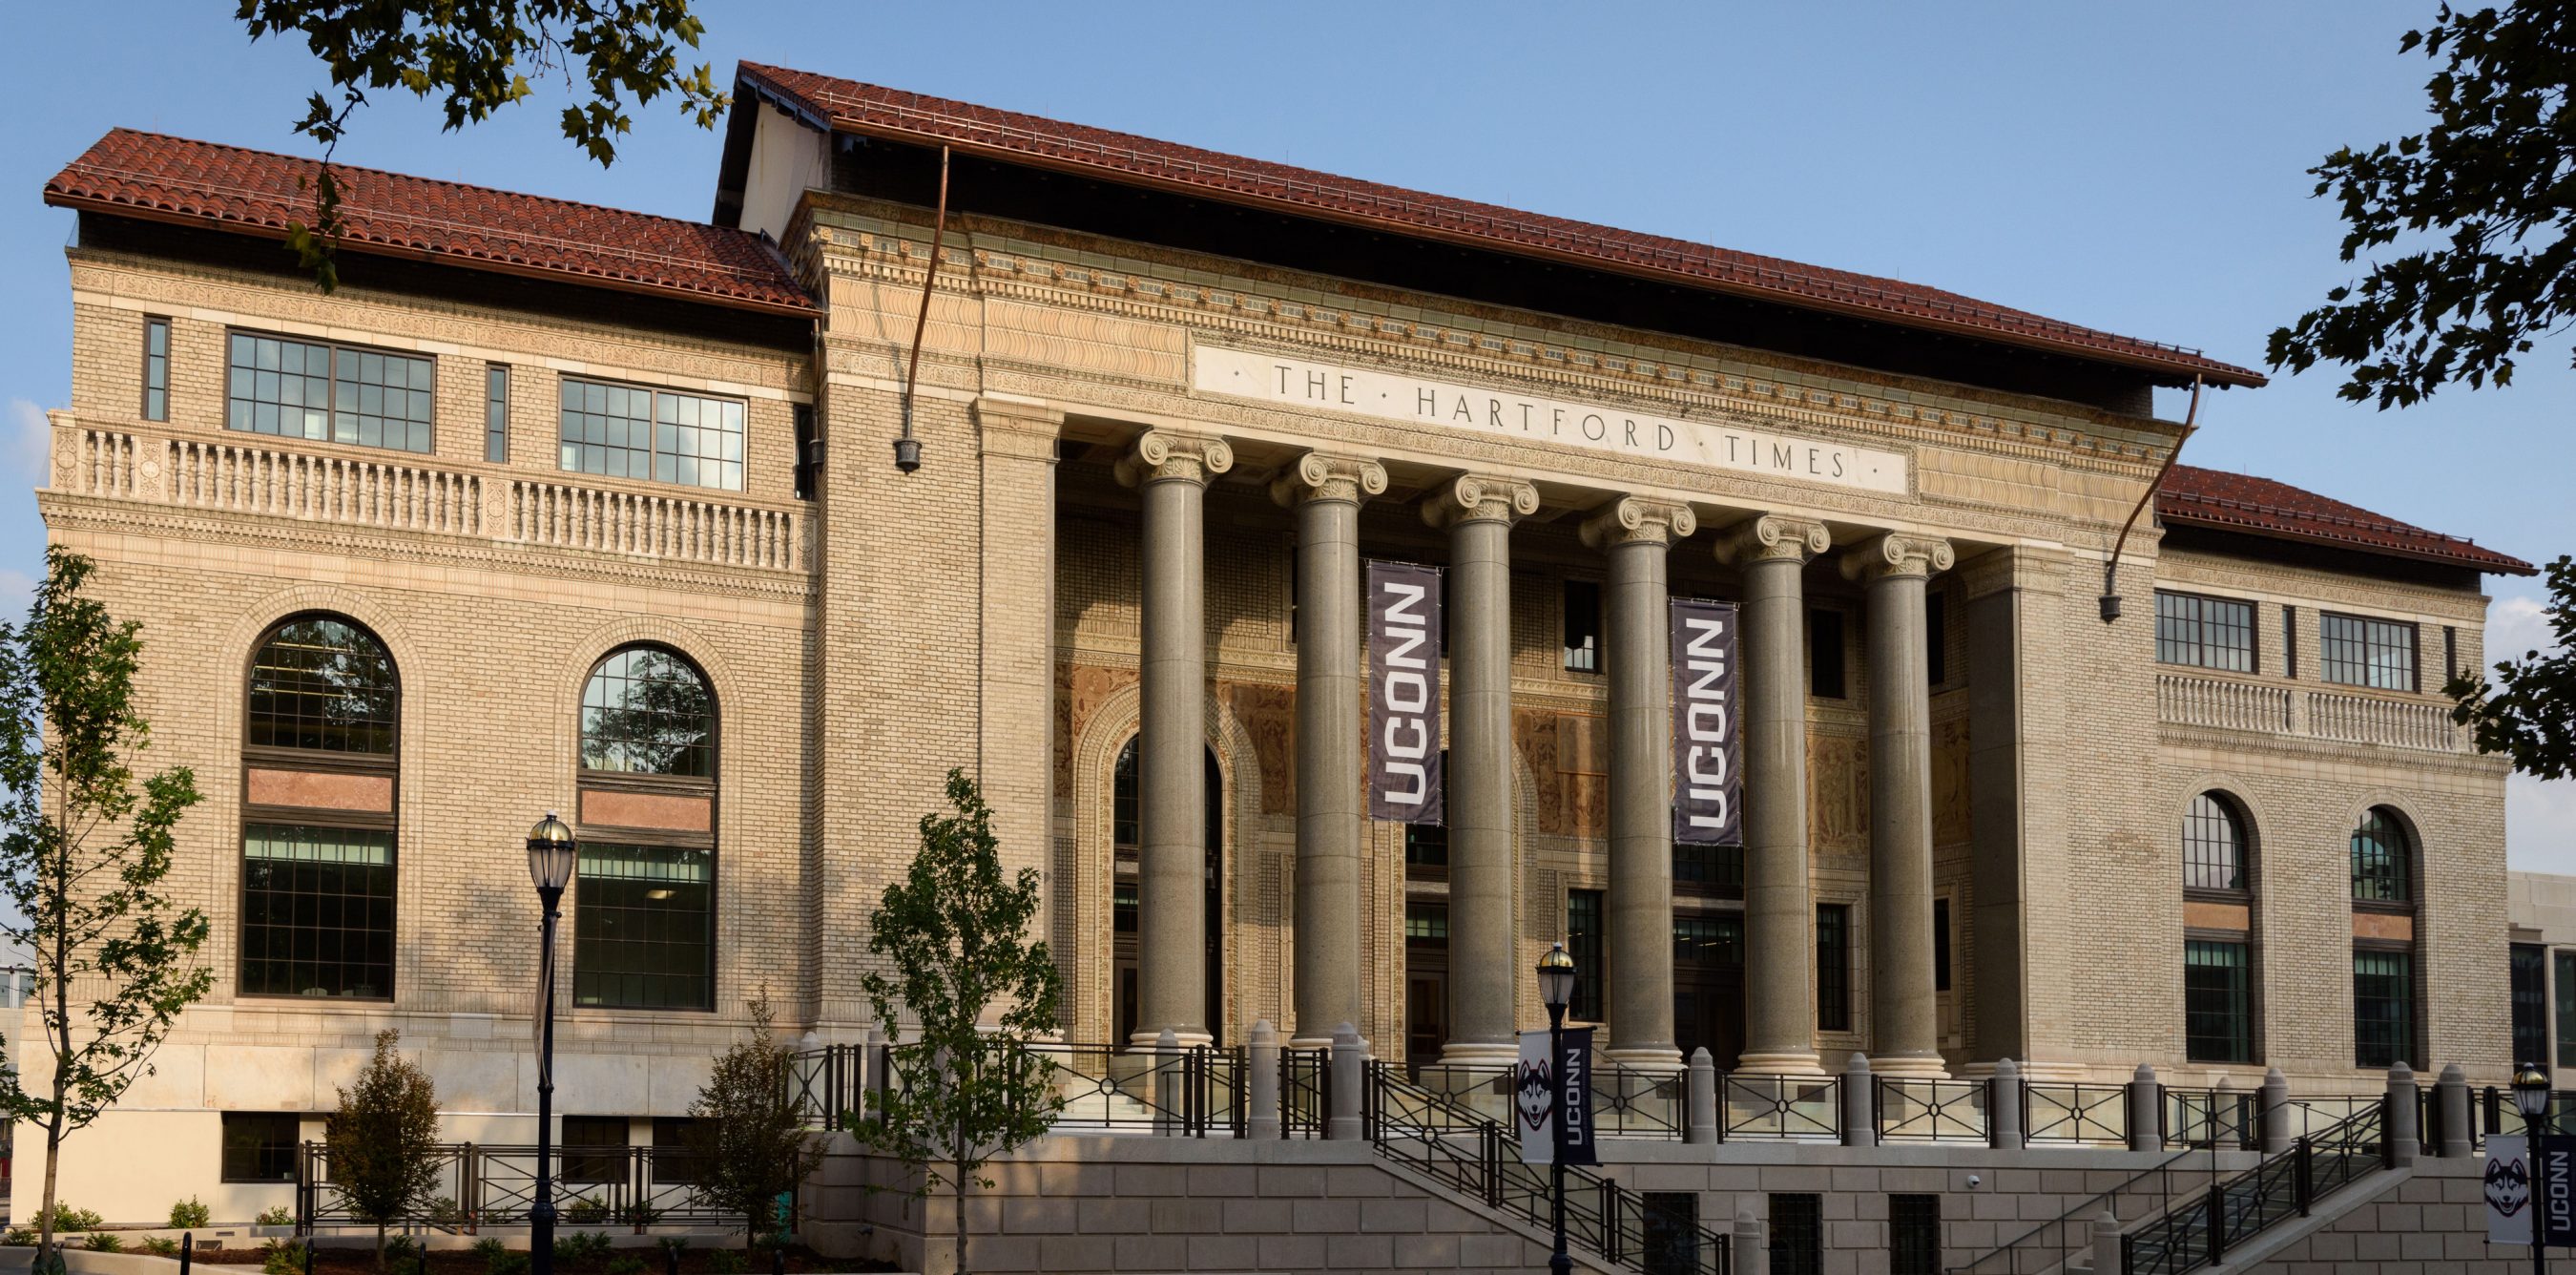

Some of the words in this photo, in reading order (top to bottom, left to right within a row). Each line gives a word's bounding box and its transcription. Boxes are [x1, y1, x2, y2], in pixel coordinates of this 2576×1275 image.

[1274, 365, 1357, 405] THE
[1417, 387, 1675, 451] HARTFORD
[1725, 434, 1845, 478] TIMES
[1383, 582, 1427, 805] UCONN
[1686, 617, 1727, 829] UCONN
[1566, 1048, 1583, 1145] UCONN
[2549, 1151, 2571, 1231] UCONN
